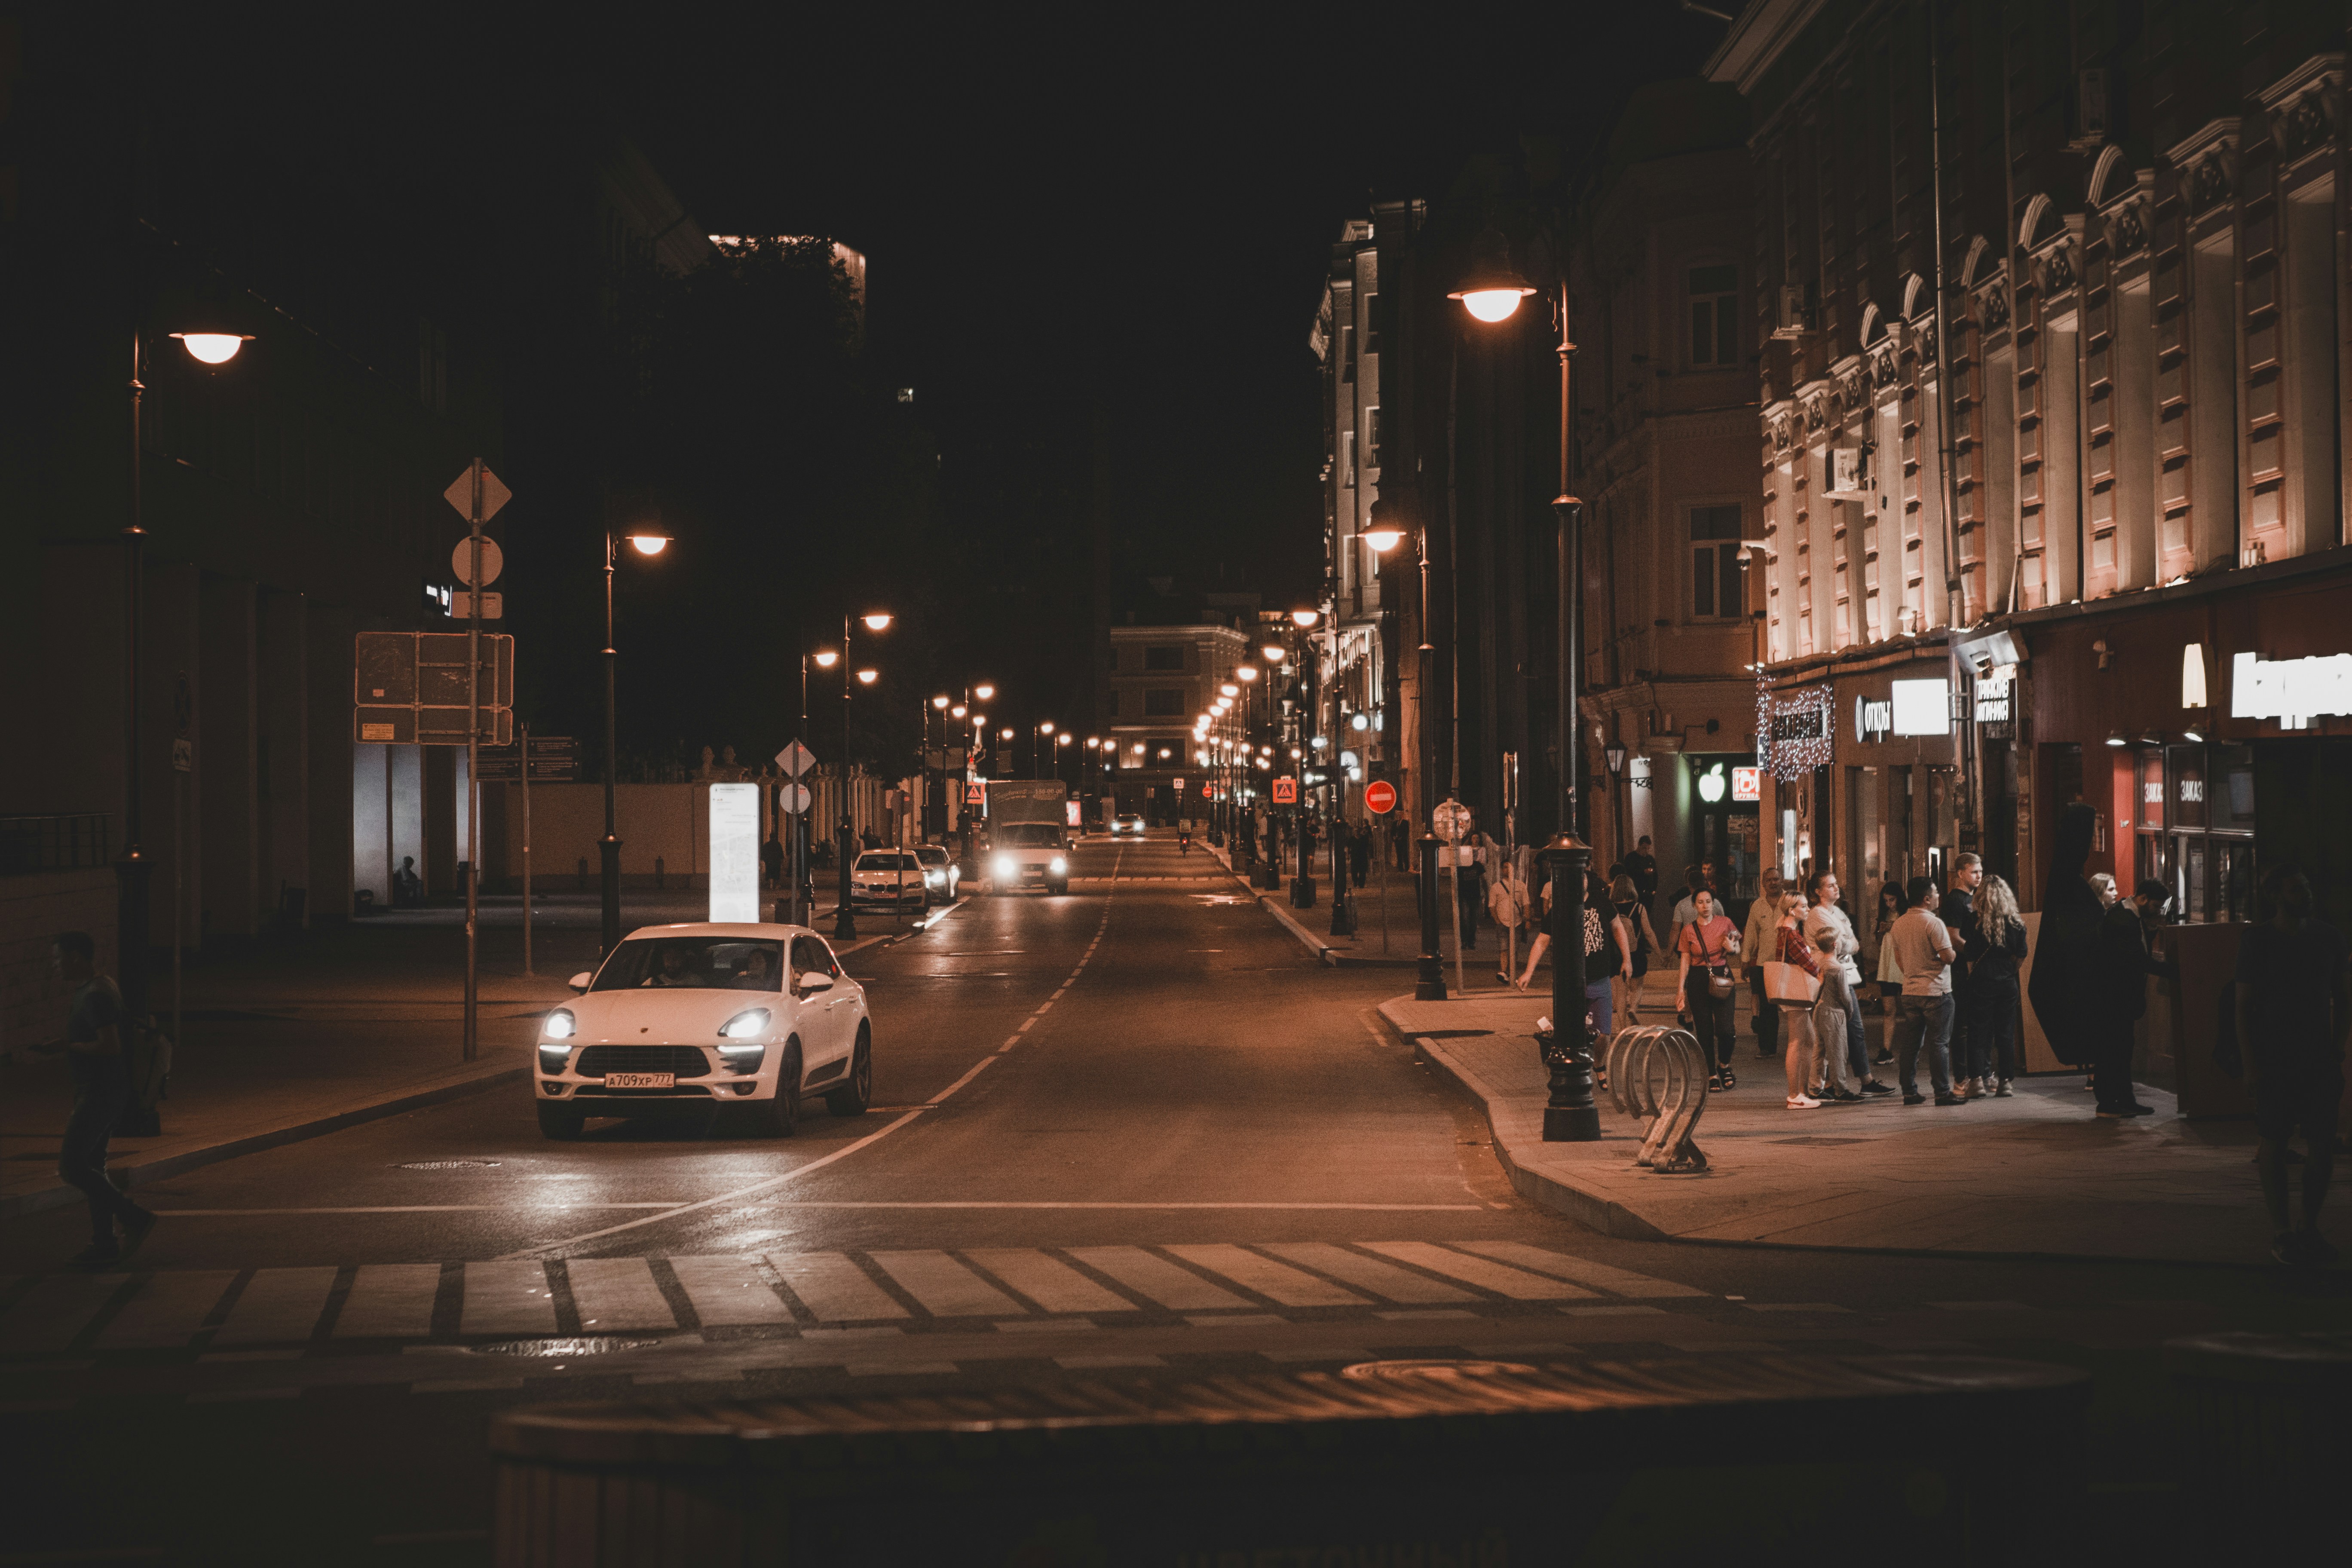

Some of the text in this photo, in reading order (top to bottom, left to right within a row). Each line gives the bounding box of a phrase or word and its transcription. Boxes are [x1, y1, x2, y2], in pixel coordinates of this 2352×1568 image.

[2180, 780, 2203, 802] ЗАКАЗ
[609, 1074, 671, 1086] А709ХР 777
